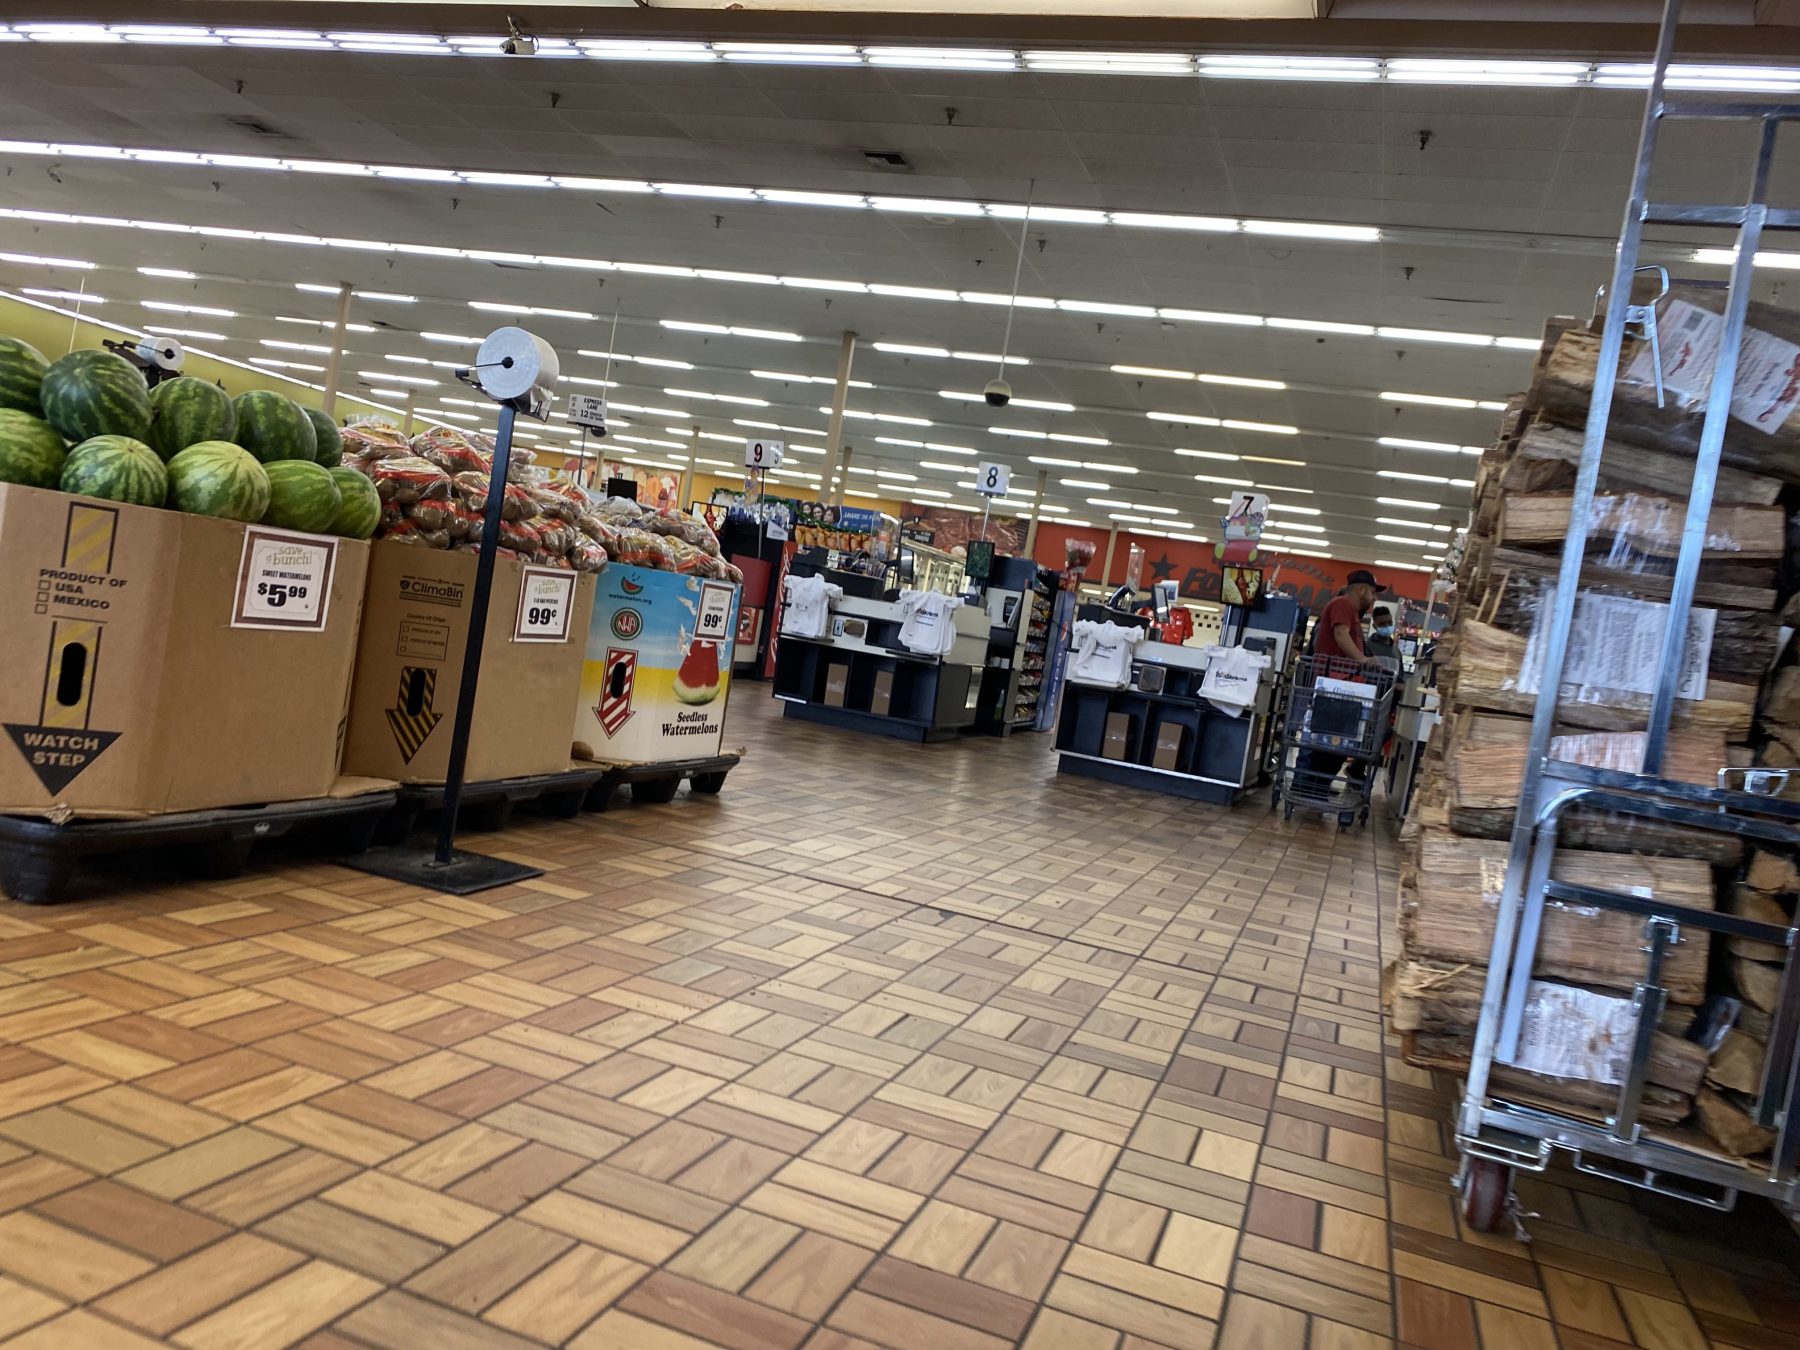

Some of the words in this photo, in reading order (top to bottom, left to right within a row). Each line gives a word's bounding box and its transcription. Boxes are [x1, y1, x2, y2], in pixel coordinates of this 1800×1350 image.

[581, 409, 589, 418] 12
[754, 443, 763, 463] 9
[986, 466, 999, 488] 8
[1243, 495, 1255, 516] 7
[273, 550, 313, 566] bunch!
[278, 545, 304, 555] save
[40, 569, 106, 586] PRODUCT
[109, 578, 128, 588] OF
[262, 569, 278, 578] SWEET
[55, 582, 84, 594] USA
[411, 581, 463, 599] ClimaBin
[53, 594, 110, 610] MEXICO
[608, 593, 653, 606] watermelon.org
[677, 711, 708, 723] Seedless
[662, 722, 719, 737] Watermelons
[23, 732, 99, 750] WATCH
[32, 751, 86, 767] STEP
